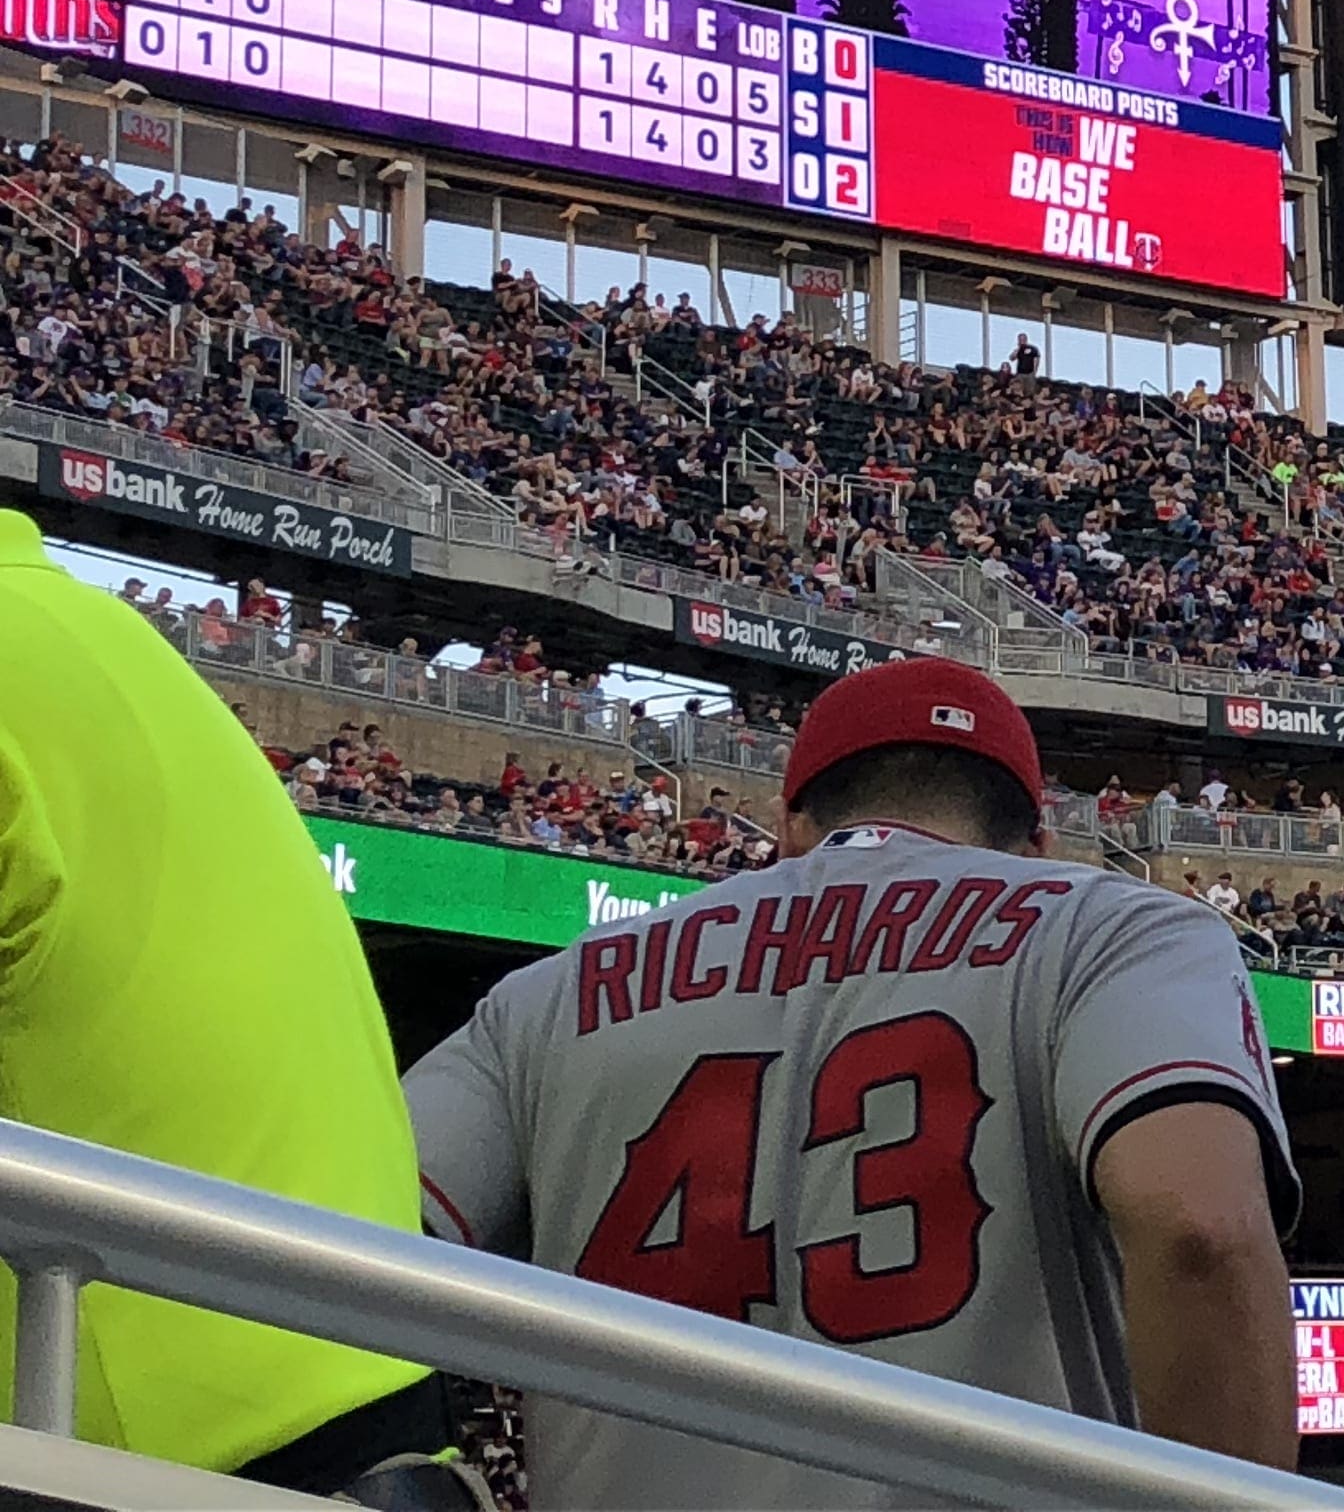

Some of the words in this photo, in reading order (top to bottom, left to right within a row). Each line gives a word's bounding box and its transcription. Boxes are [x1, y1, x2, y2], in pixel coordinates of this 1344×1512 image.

[737, 21, 781, 61] LOB
[983, 62, 1113, 113] SCOREBOARD
[1118, 90, 1179, 126] POSTS
[1079, 117, 1136, 171] WE
[1010, 151, 1110, 214] BASE
[1042, 210, 1133, 268] BALL
[195, 484, 264, 537] Home
[272, 505, 322, 549] Run
[330, 524, 394, 568] Porch
[788, 627, 841, 671] Home
[577, 878, 1074, 1036] RICHARDS
[576, 1009, 996, 1344] 43
